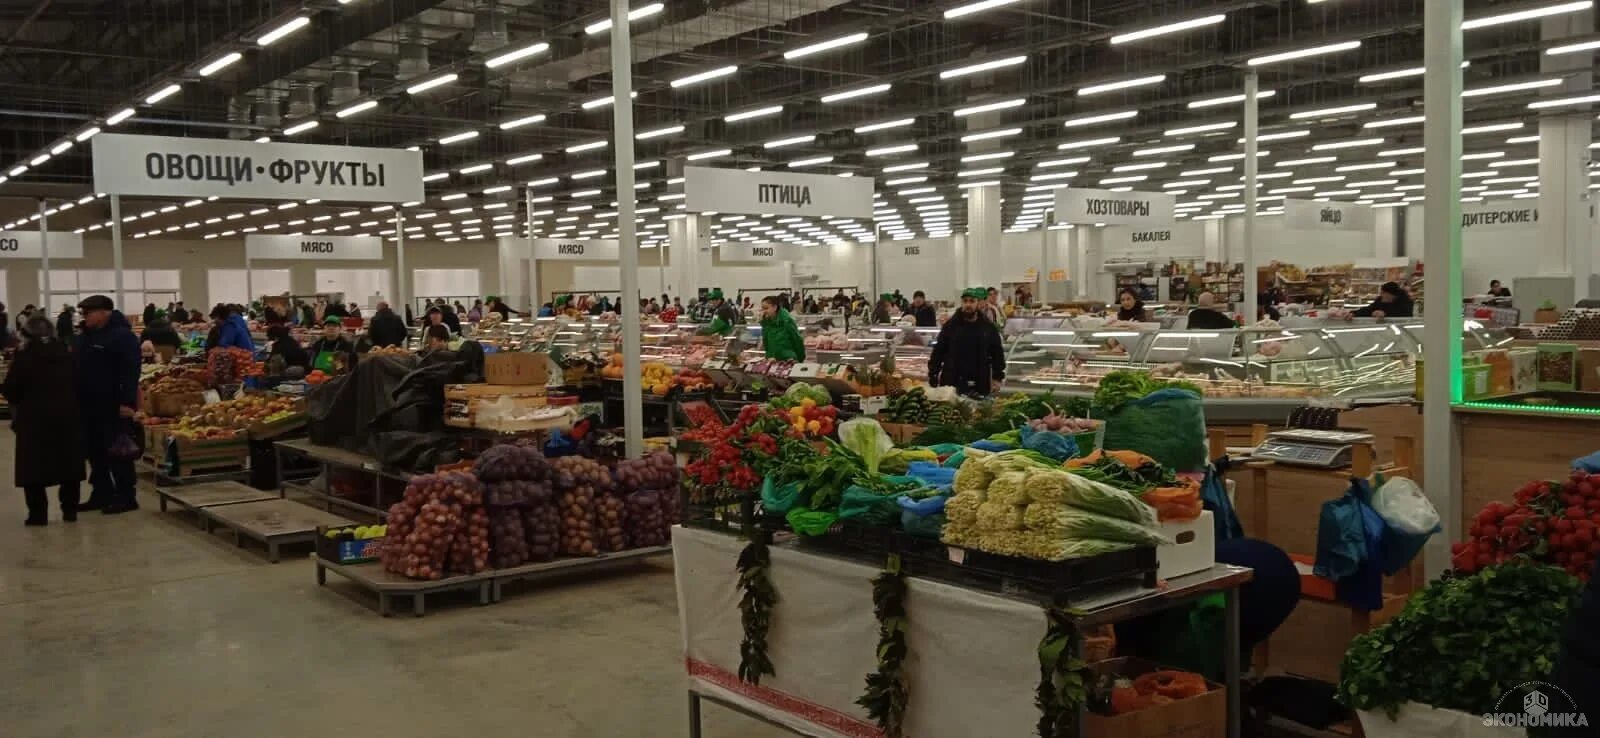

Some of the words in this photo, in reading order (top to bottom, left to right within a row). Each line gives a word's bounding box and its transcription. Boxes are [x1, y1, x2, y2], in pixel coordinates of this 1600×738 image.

[758, 184, 811, 208] ПТИЦА
[1086, 198, 1149, 217] ХОЗТОВАРЫ
[1320, 207, 1342, 224] ЯЙЦО
[1132, 230, 1171, 242] БАКАЛЕЯ
[301, 241, 334, 254] МЯСО
[558, 244, 584, 255] МЯСО
[752, 247, 774, 257] МЯСО
